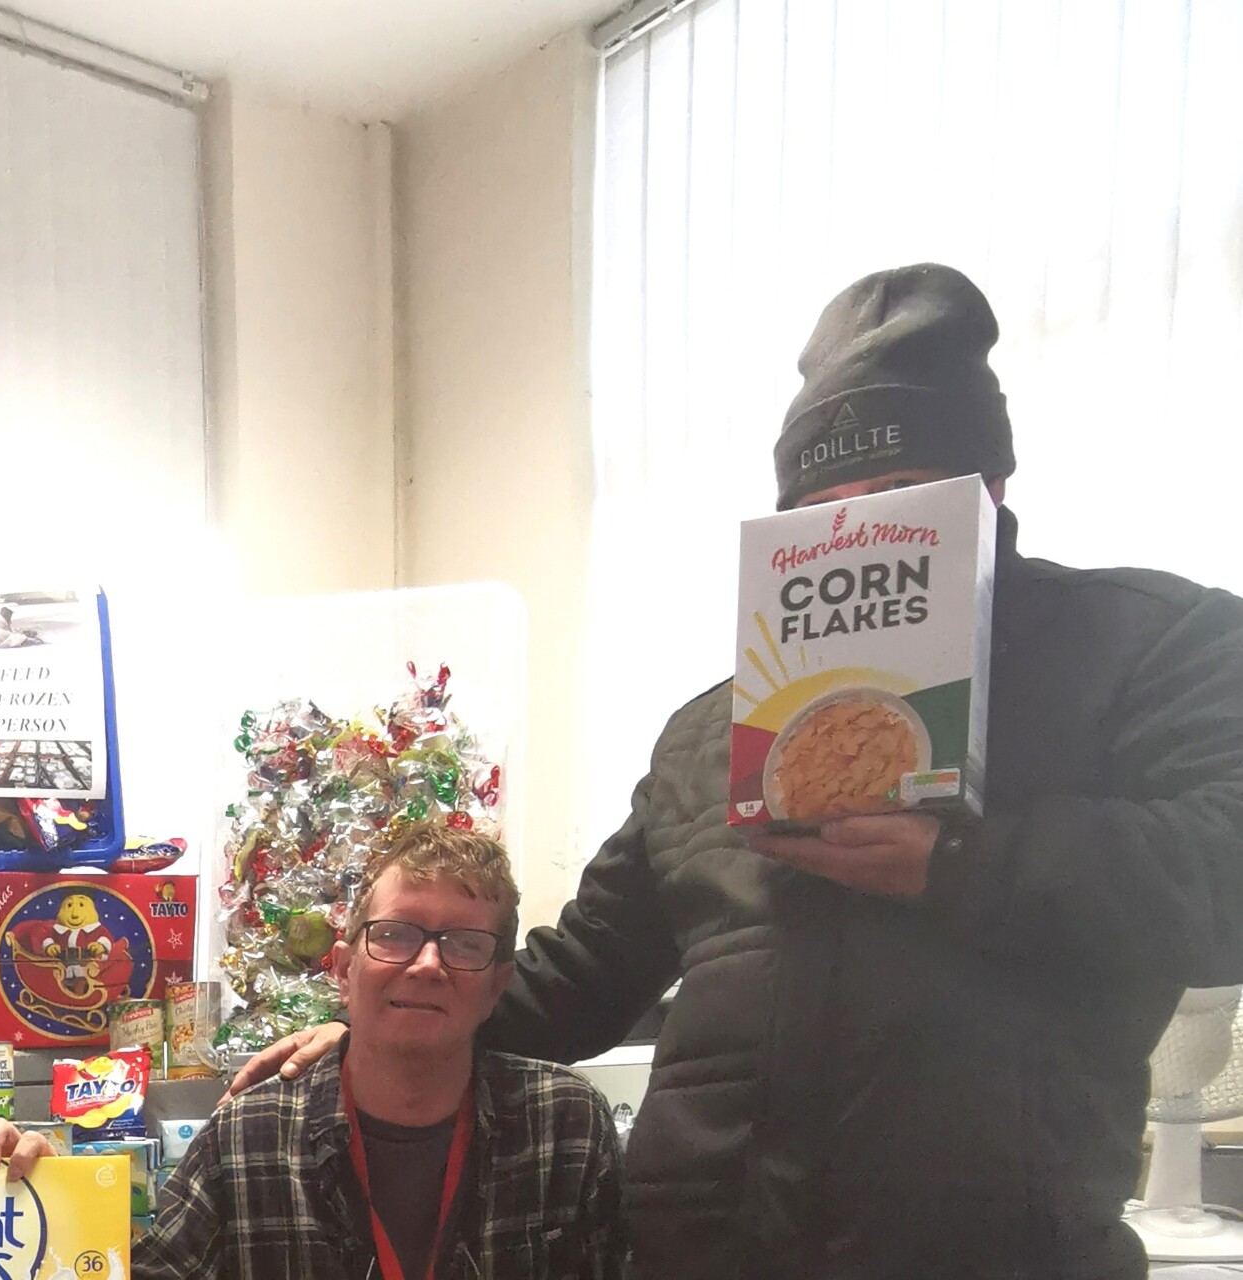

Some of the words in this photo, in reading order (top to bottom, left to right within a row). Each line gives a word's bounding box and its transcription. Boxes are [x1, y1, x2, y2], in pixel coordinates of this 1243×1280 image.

[800, 424, 902, 469] COILLTE
[771, 521, 868, 574] Harvest
[873, 522, 941, 548] Morn
[779, 555, 930, 611] CORN
[781, 595, 928, 643] FLAKES
[0, 666, 50, 682] FEED
[149, 902, 189, 918] TAYTO
[66, 1079, 135, 1100] TAYO
[81, 1255, 104, 1274] 36
